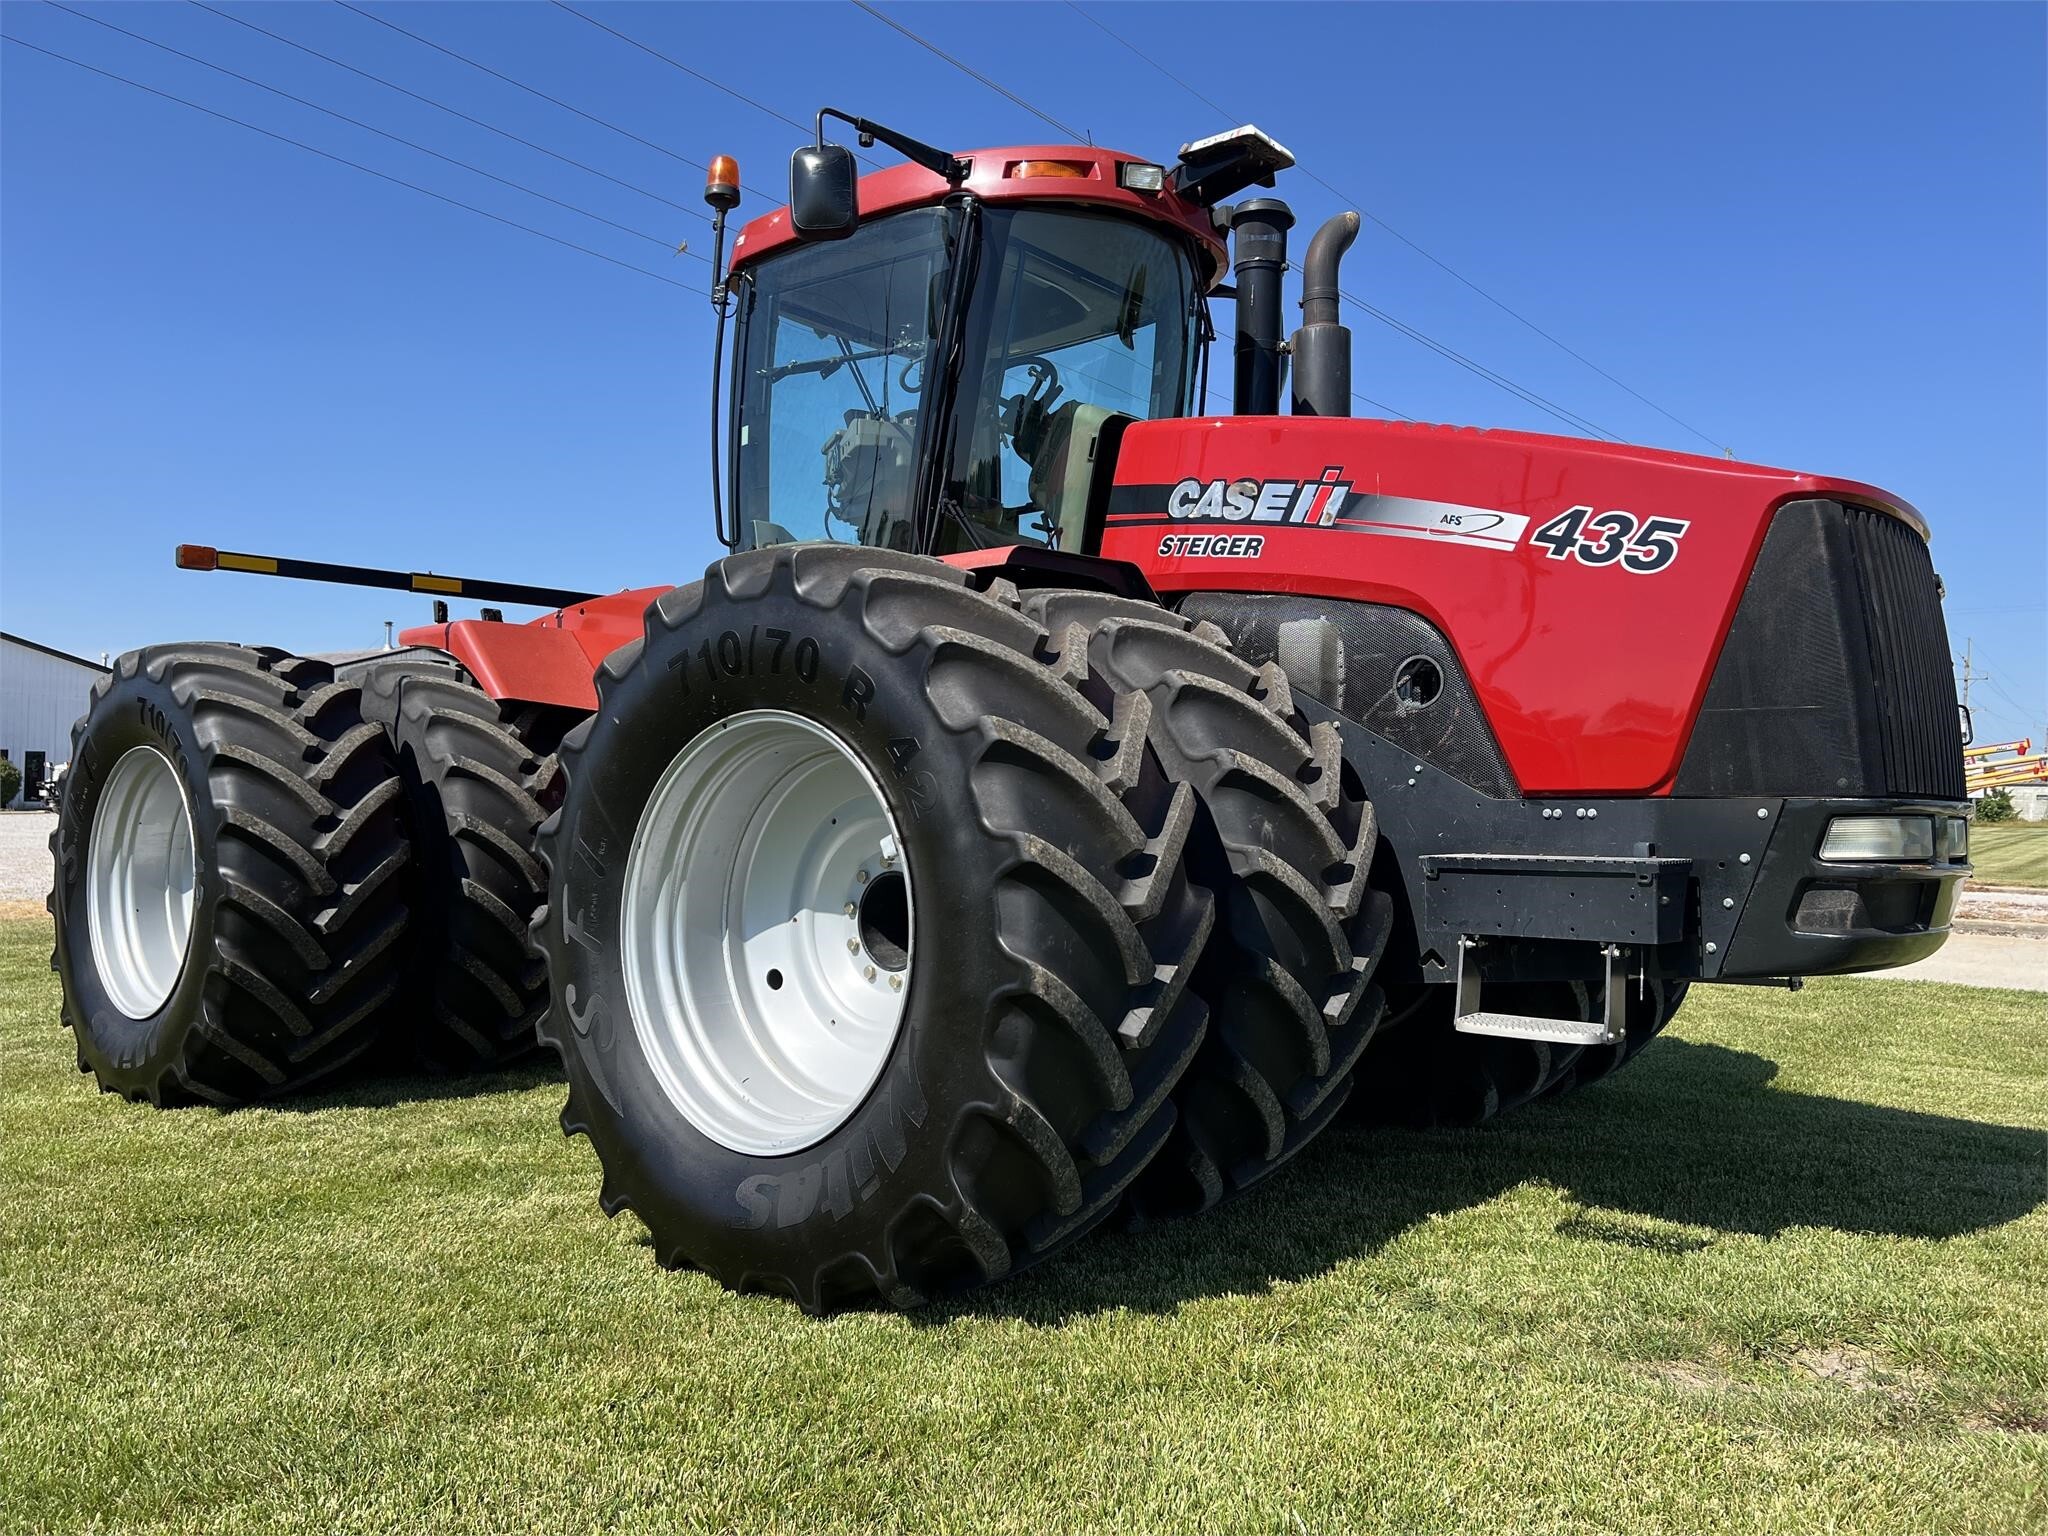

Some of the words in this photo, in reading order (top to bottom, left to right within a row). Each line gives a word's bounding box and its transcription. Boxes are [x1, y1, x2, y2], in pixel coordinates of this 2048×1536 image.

[1168, 480, 1297, 521] CASE
[1439, 513, 1463, 526] AFS
[1157, 534, 1265, 559] STEIGER
[1529, 505, 1691, 575] 435
[665, 623, 821, 698] 710/70
[842, 664, 877, 727] R
